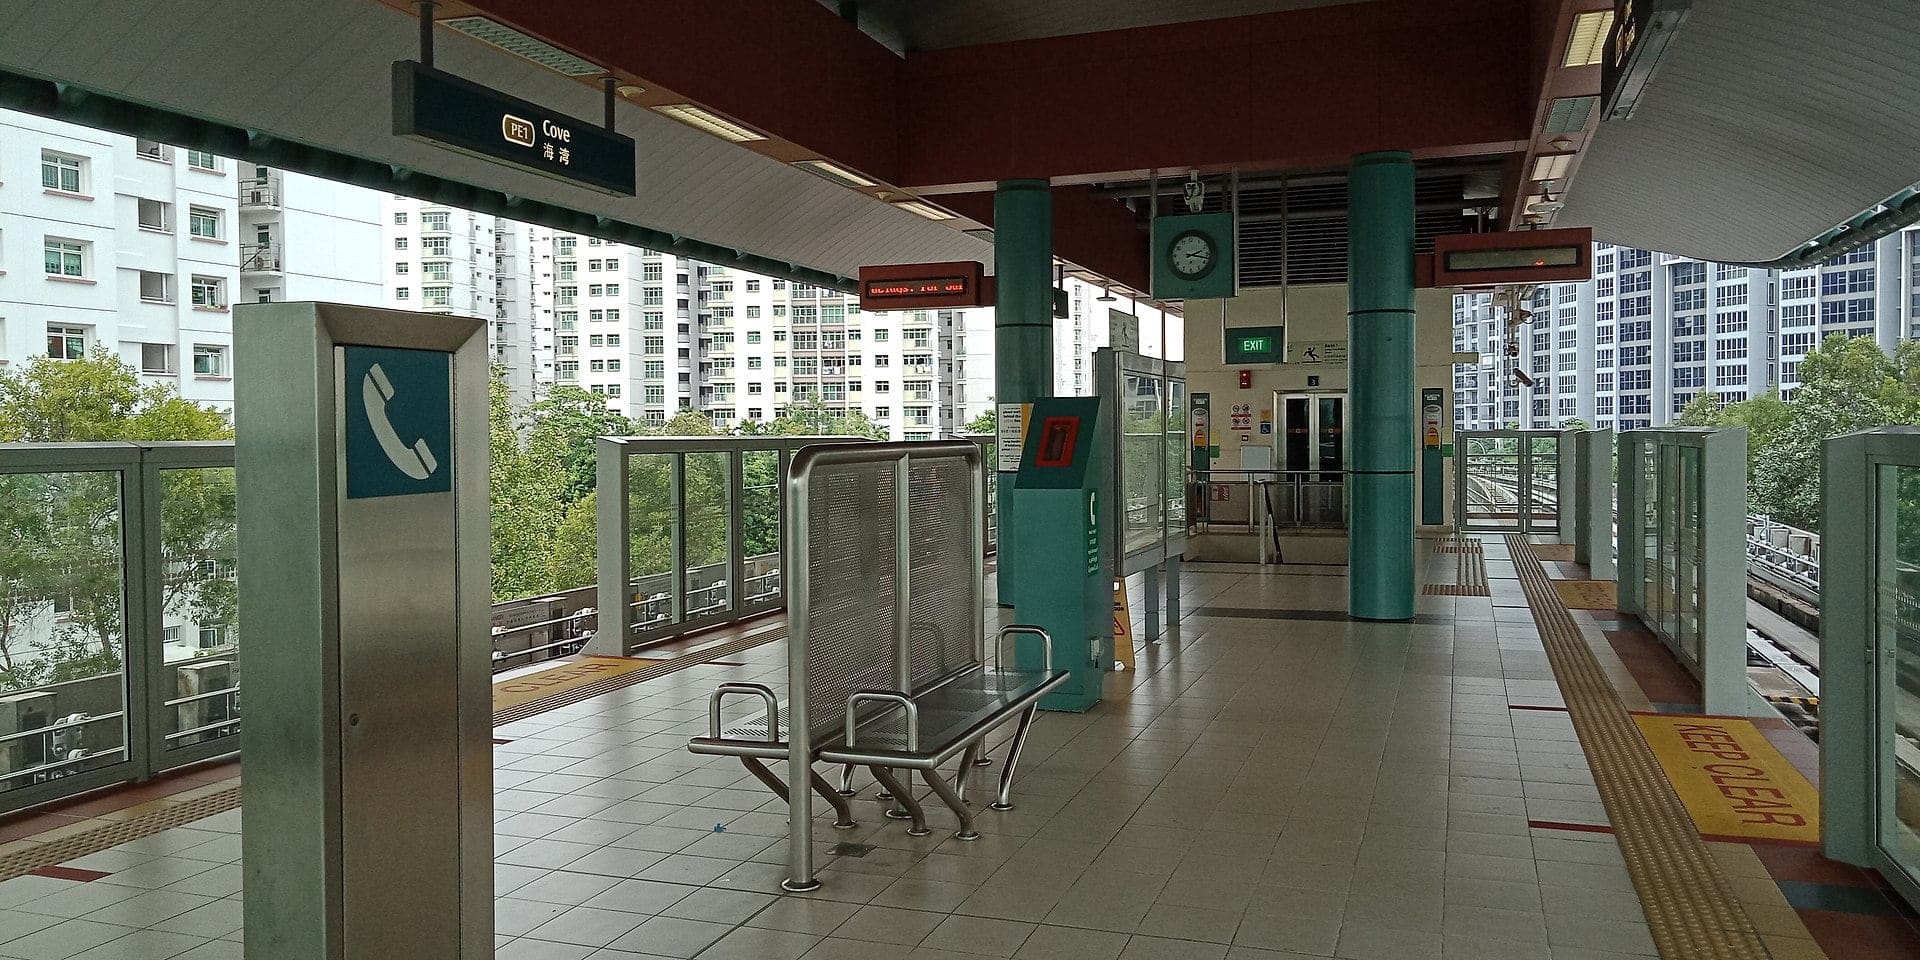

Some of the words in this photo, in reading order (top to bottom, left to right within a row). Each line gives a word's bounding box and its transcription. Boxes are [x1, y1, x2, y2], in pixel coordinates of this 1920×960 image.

[511, 122, 528, 140] PE1
[543, 119, 571, 143] Cove
[543, 142, 570, 166] 海湾
[1243, 339, 1264, 351] EXIT
[500, 663, 620, 693] CLEAR
[1673, 723, 1751, 761] KEEP
[1703, 763, 1807, 827] CLEAR
